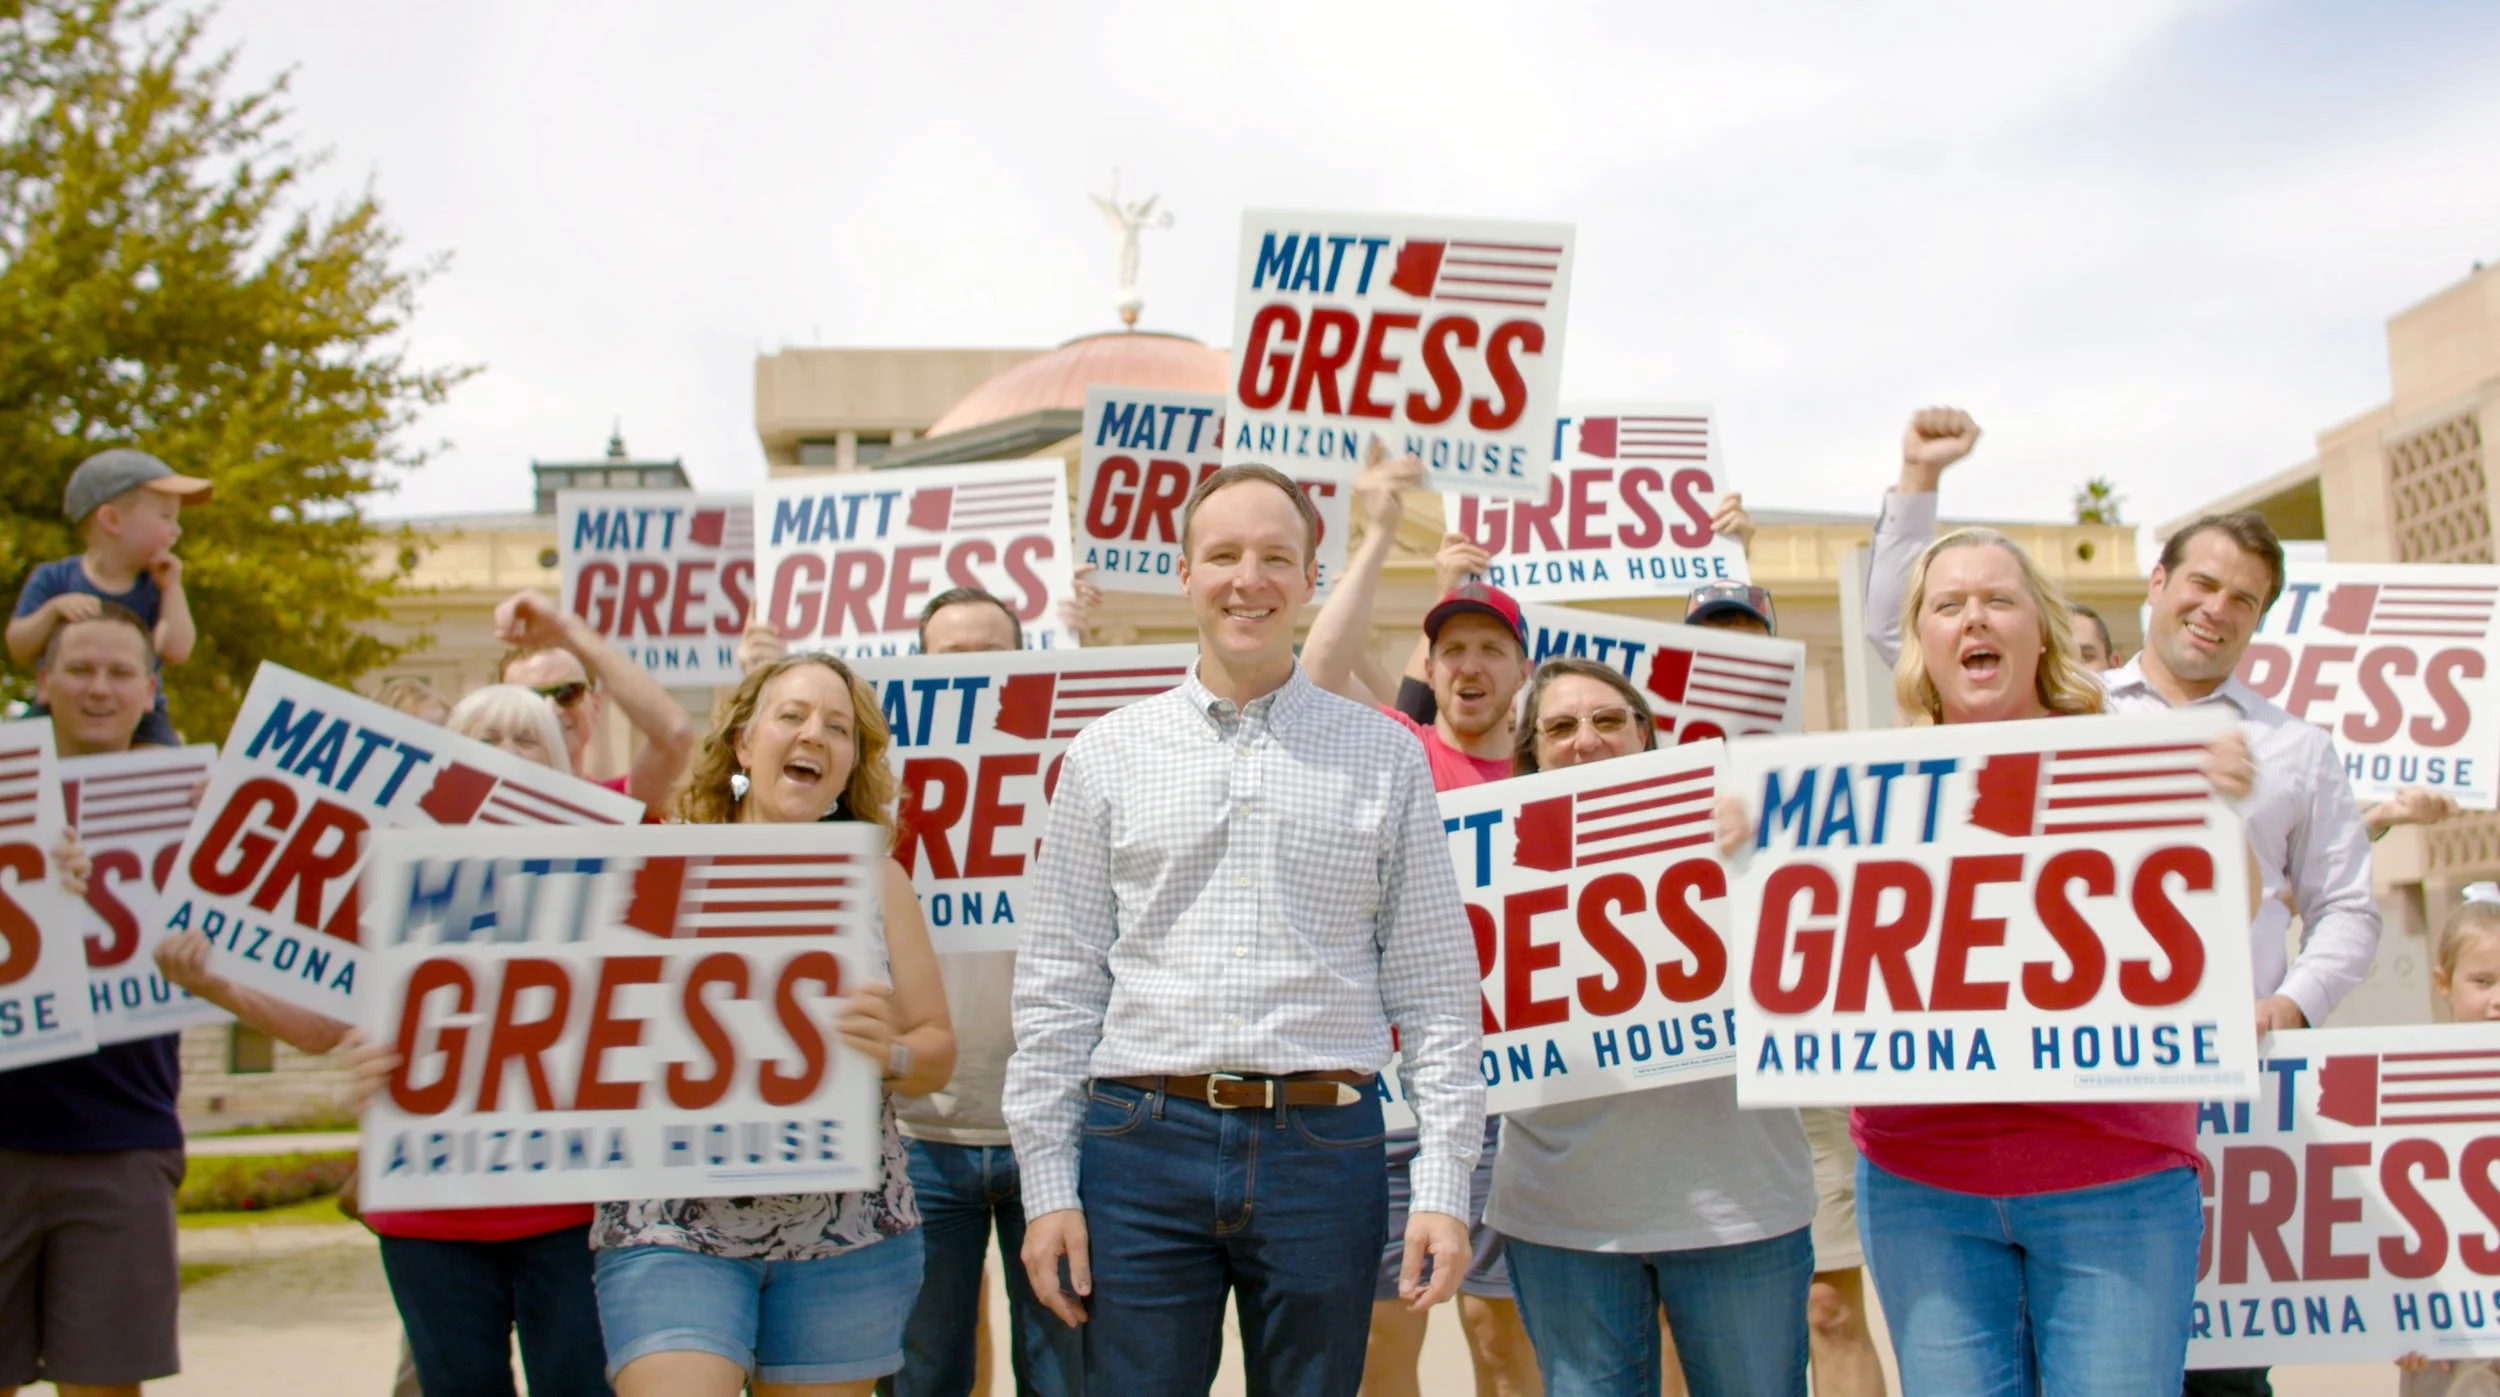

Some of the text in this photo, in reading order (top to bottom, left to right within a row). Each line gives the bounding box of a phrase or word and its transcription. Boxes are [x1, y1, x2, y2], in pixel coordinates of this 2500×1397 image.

[1251, 233, 1390, 296] MATT
[1237, 304, 1546, 430] GRESS
[1096, 402, 1213, 453] MATT
[1404, 433, 1529, 477] HOUSE
[574, 510, 683, 552] MATT
[773, 490, 902, 545] MATT
[1086, 547, 1181, 575] ARIZO
[1627, 557, 1728, 580] HOUSE
[574, 559, 754, 638] GRES
[870, 677, 990, 746] ATT
[244, 697, 434, 808] MATT
[2345, 753, 2472, 786] HOUSE
[1757, 759, 1957, 849] MATT
[398, 857, 606, 944] MATT
[1750, 846, 2214, 1015] GRESS
[89, 973, 191, 1014] HOU
[388, 950, 842, 1115] GRESS
[1757, 1027, 1996, 1076] ARIZONA
[2031, 1023, 2219, 1069] HOUSE
[382, 1118, 845, 1176] ARIZONA HOUSE
[2191, 1290, 2500, 1338] RIZONA HOU
